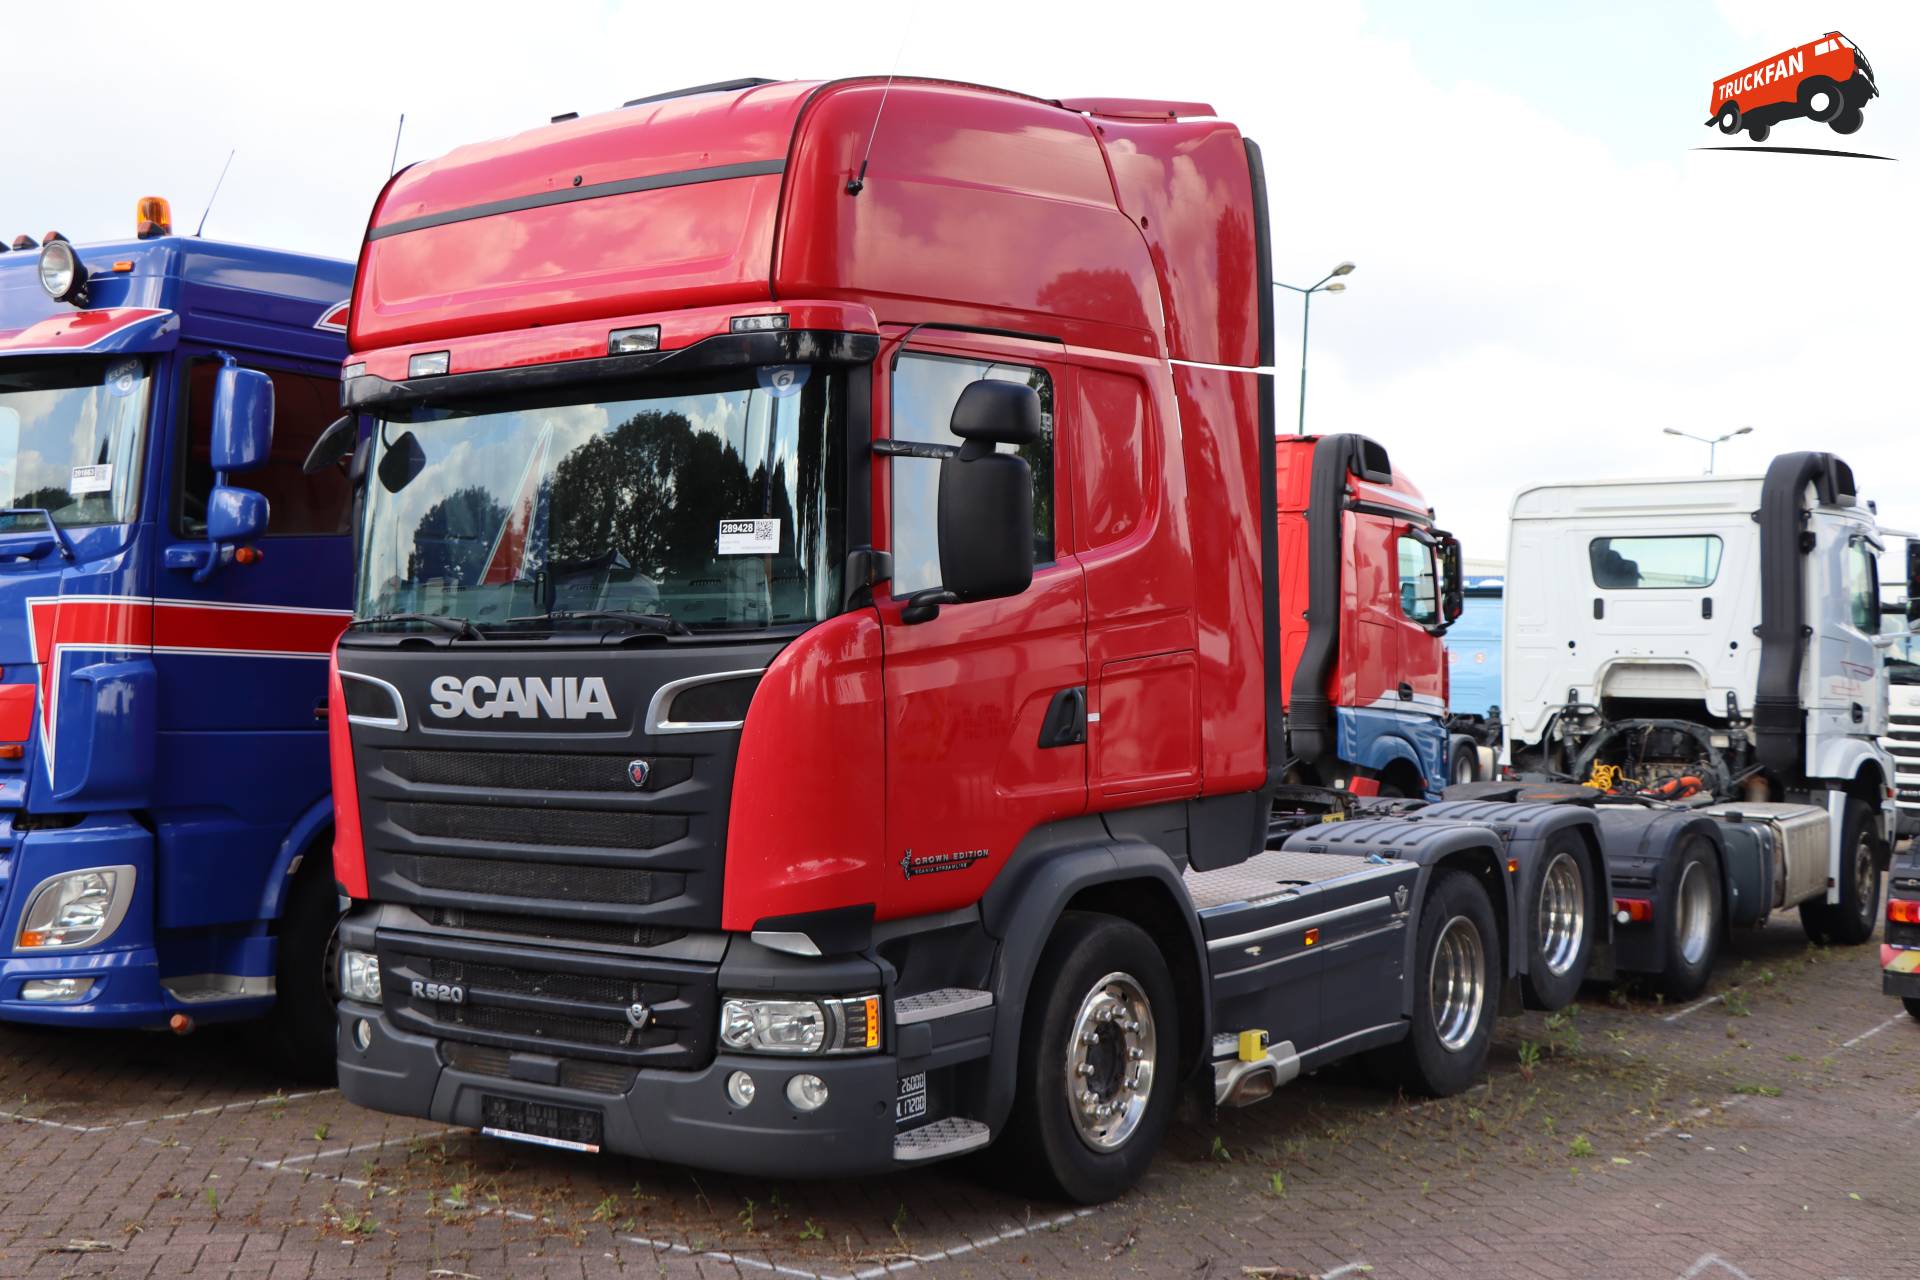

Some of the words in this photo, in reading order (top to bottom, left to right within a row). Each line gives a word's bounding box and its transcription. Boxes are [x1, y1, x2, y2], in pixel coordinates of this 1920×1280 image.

[722, 523, 754, 533] 289428
[430, 675, 618, 720] SCANIA
[914, 854, 949, 866] CROWN
[952, 849, 990, 860] EDITION
[901, 1073, 924, 1094] 26000
[904, 1095, 924, 1115] 17200
